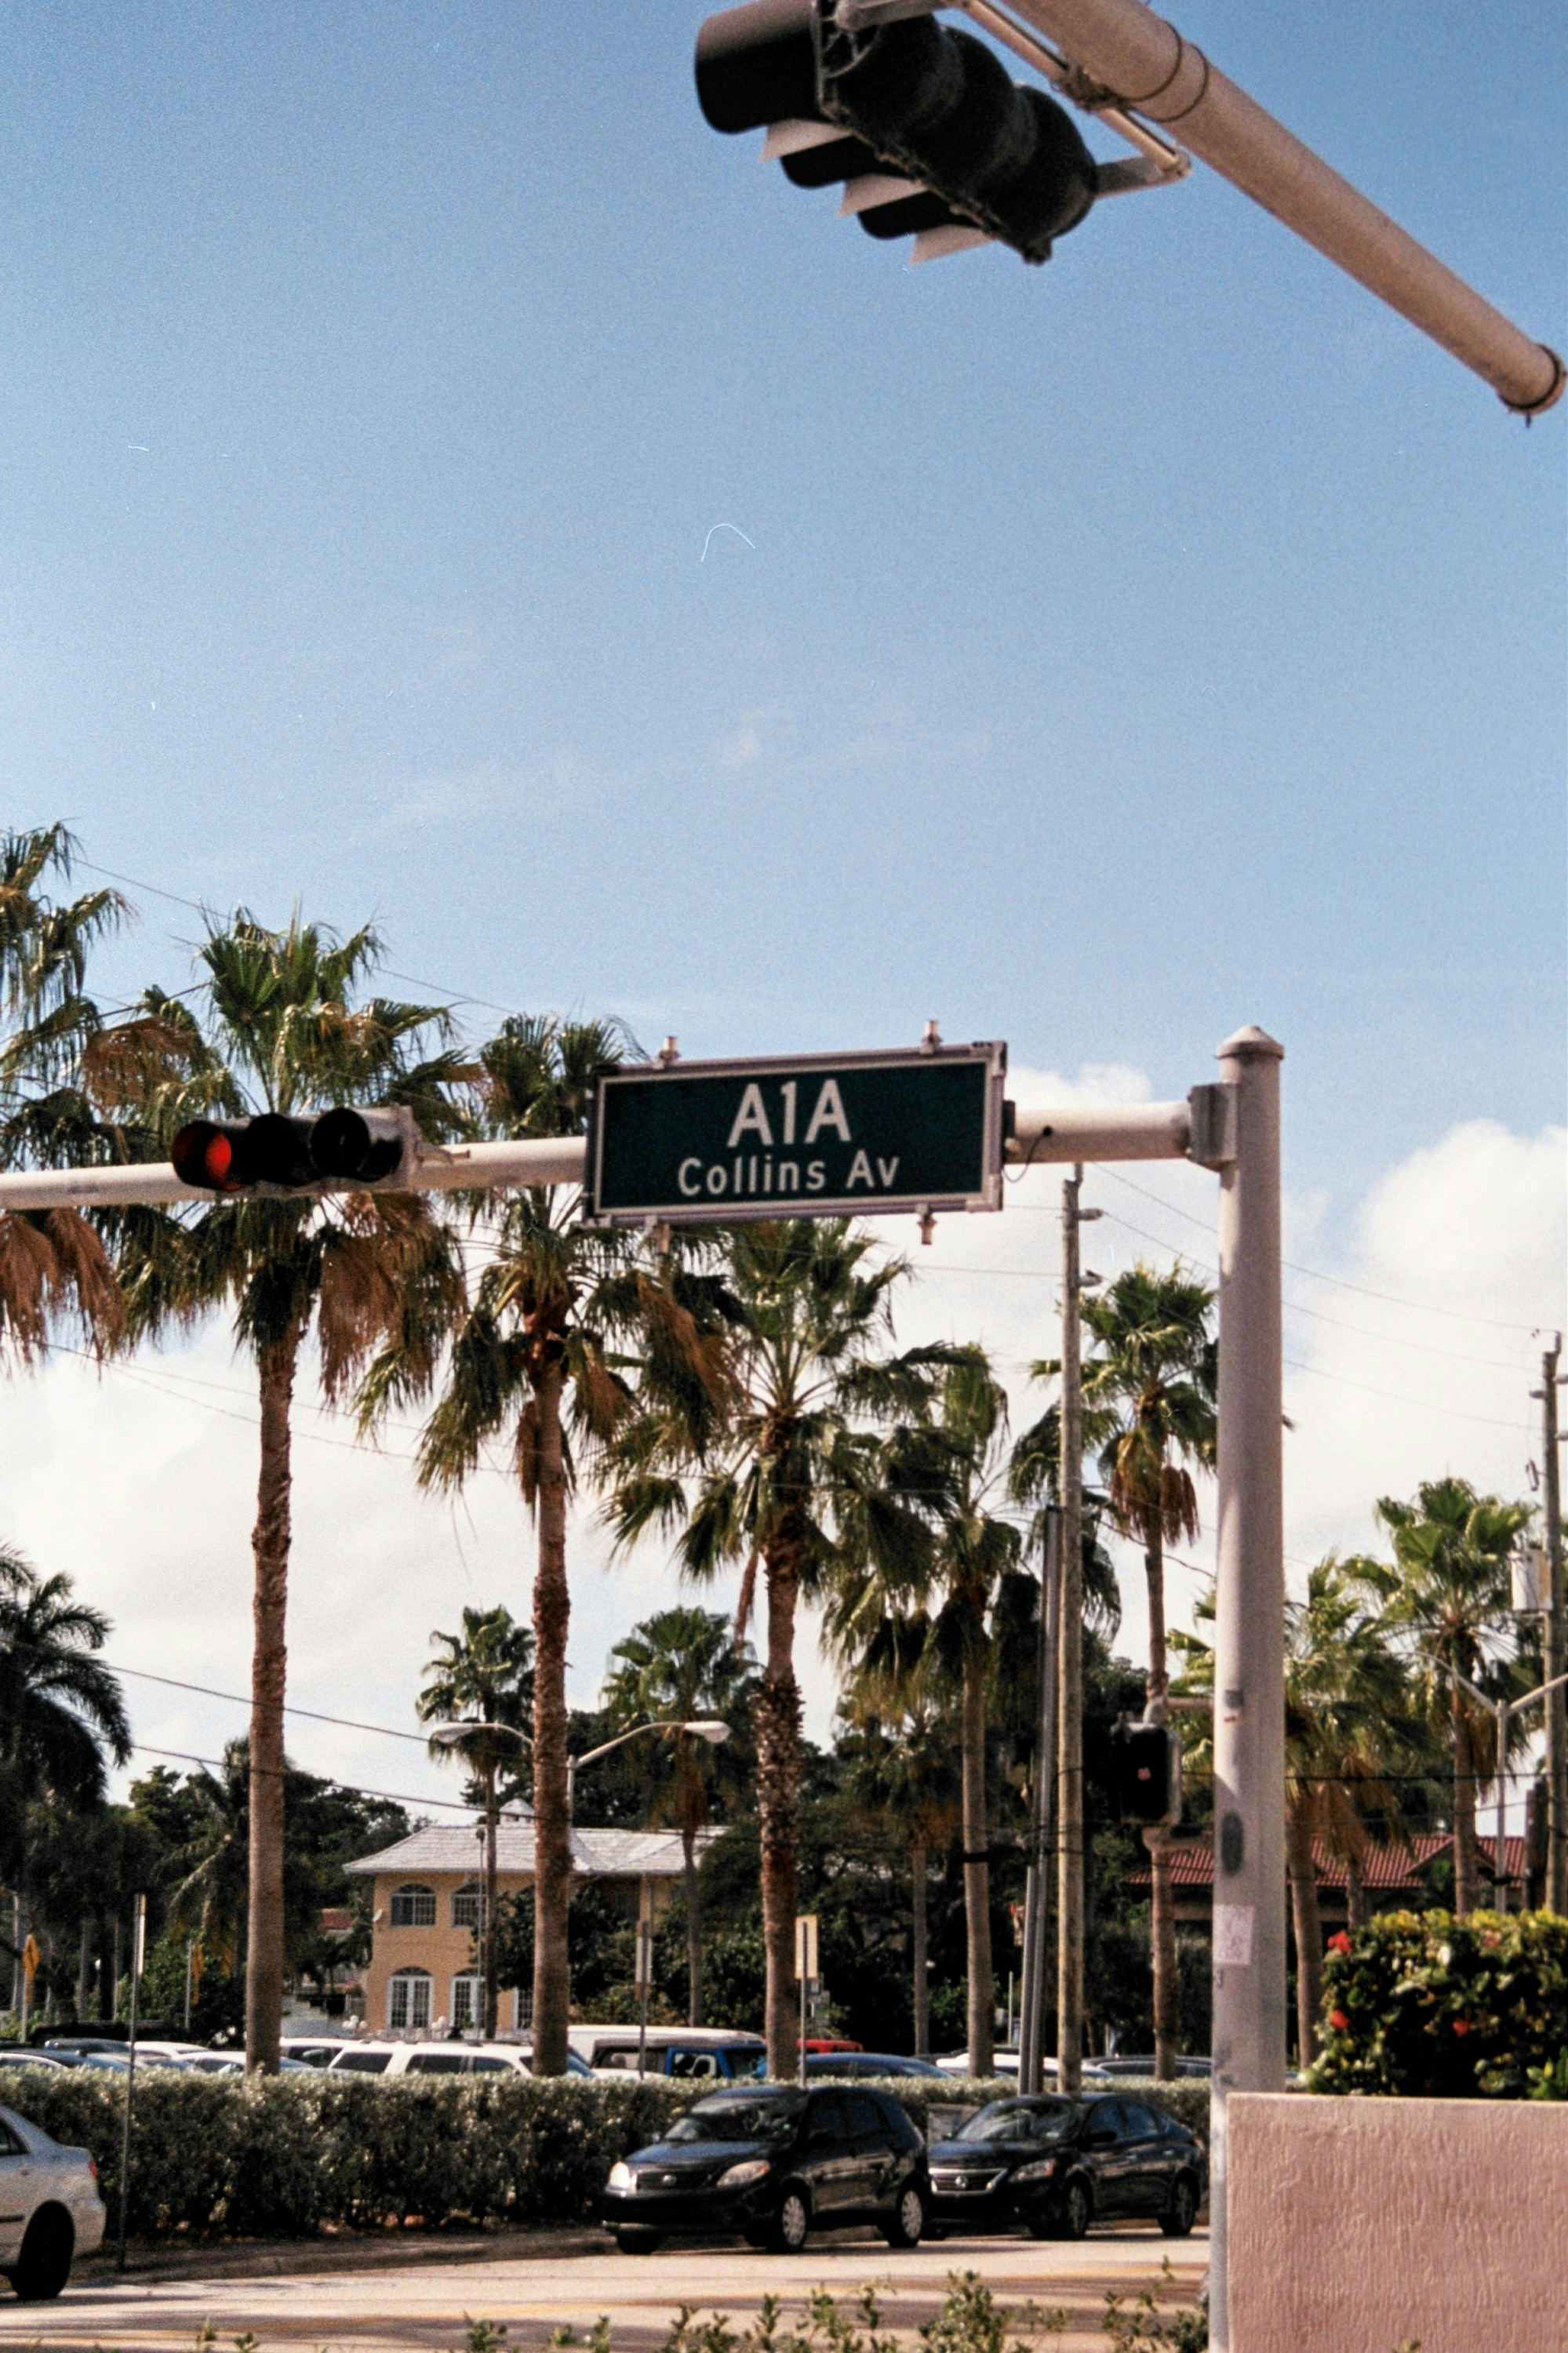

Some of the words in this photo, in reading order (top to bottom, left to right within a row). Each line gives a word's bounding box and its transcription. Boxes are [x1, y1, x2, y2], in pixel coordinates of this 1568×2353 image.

[726, 1078, 852, 1147] A1A
[678, 1154, 827, 1196] Collins
[846, 1149, 900, 1189] Av
